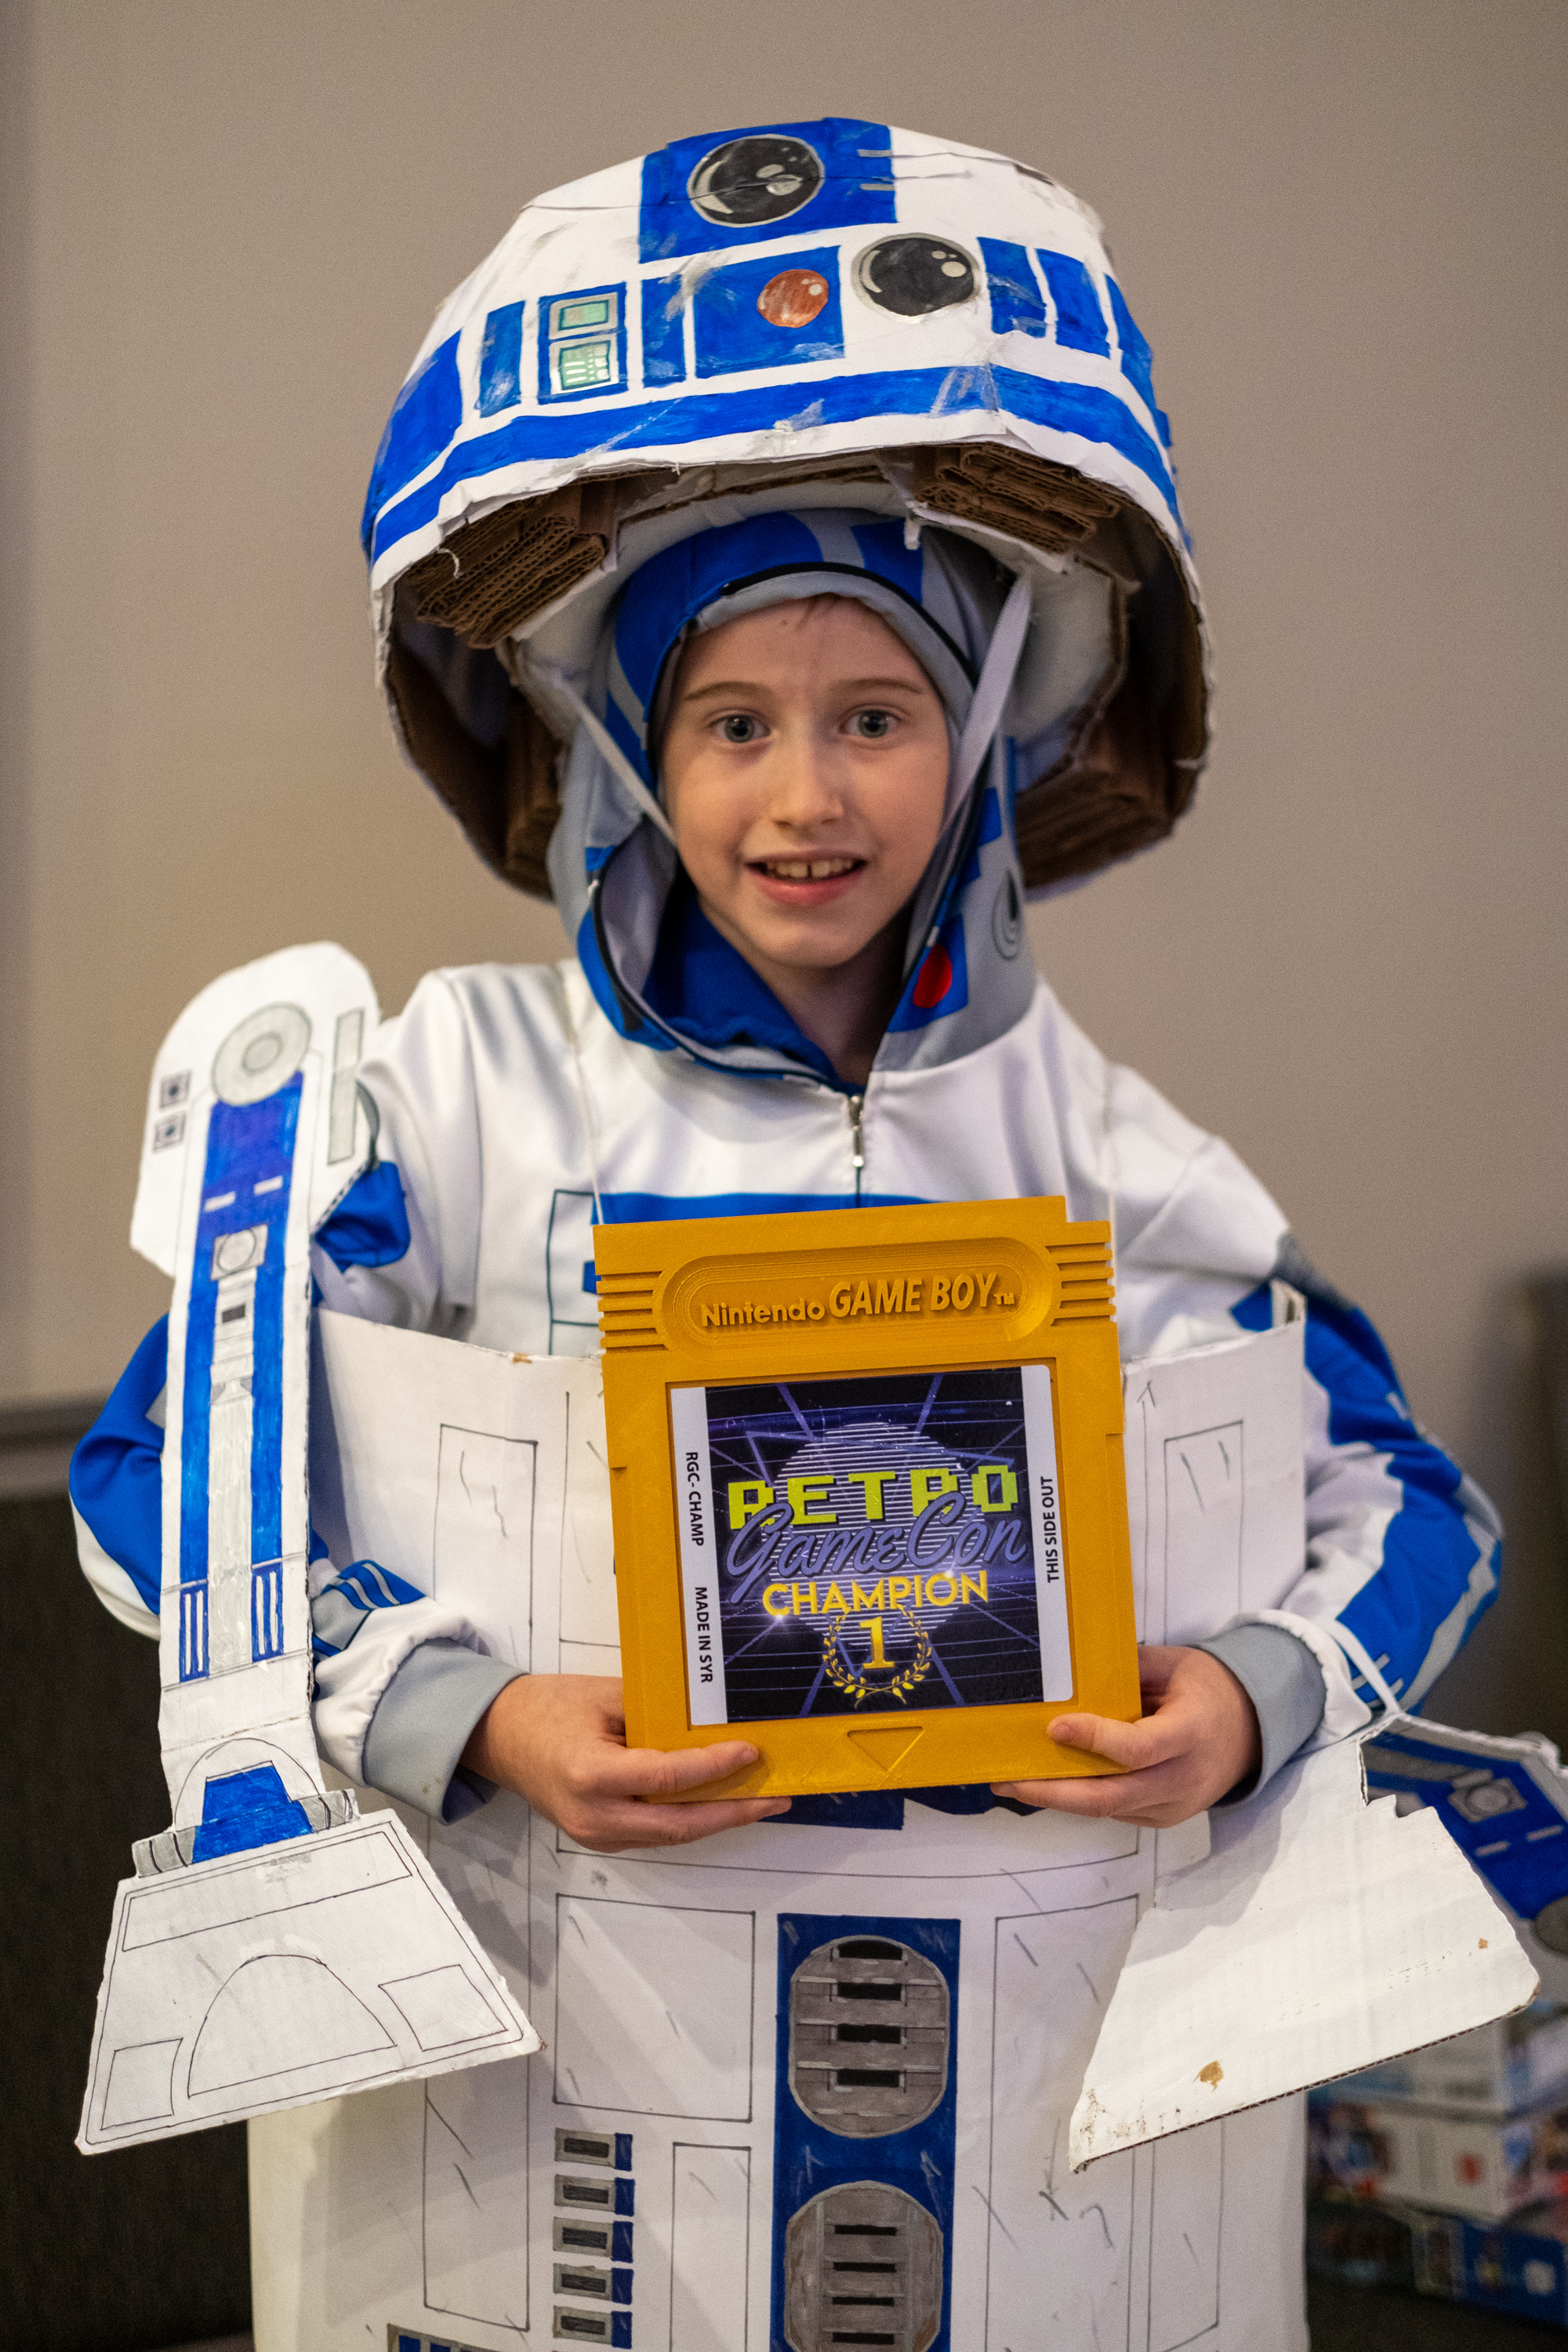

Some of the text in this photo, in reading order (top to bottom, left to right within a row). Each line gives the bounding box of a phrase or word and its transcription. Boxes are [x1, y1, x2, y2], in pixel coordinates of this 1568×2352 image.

[700, 1298, 826, 1327] Nintendo
[829, 1276, 923, 1318] GAME
[930, 1272, 997, 1312] BOY
[688, 1490, 704, 1547] CHAMP
[728, 1465, 1018, 1530] RETRO
[1040, 1475, 1060, 1584] THIS SIDE OUT
[762, 1570, 989, 1618] CHAMPION
[695, 1586, 713, 1683] MADE IN SYR
[858, 1616, 895, 1669] 1
